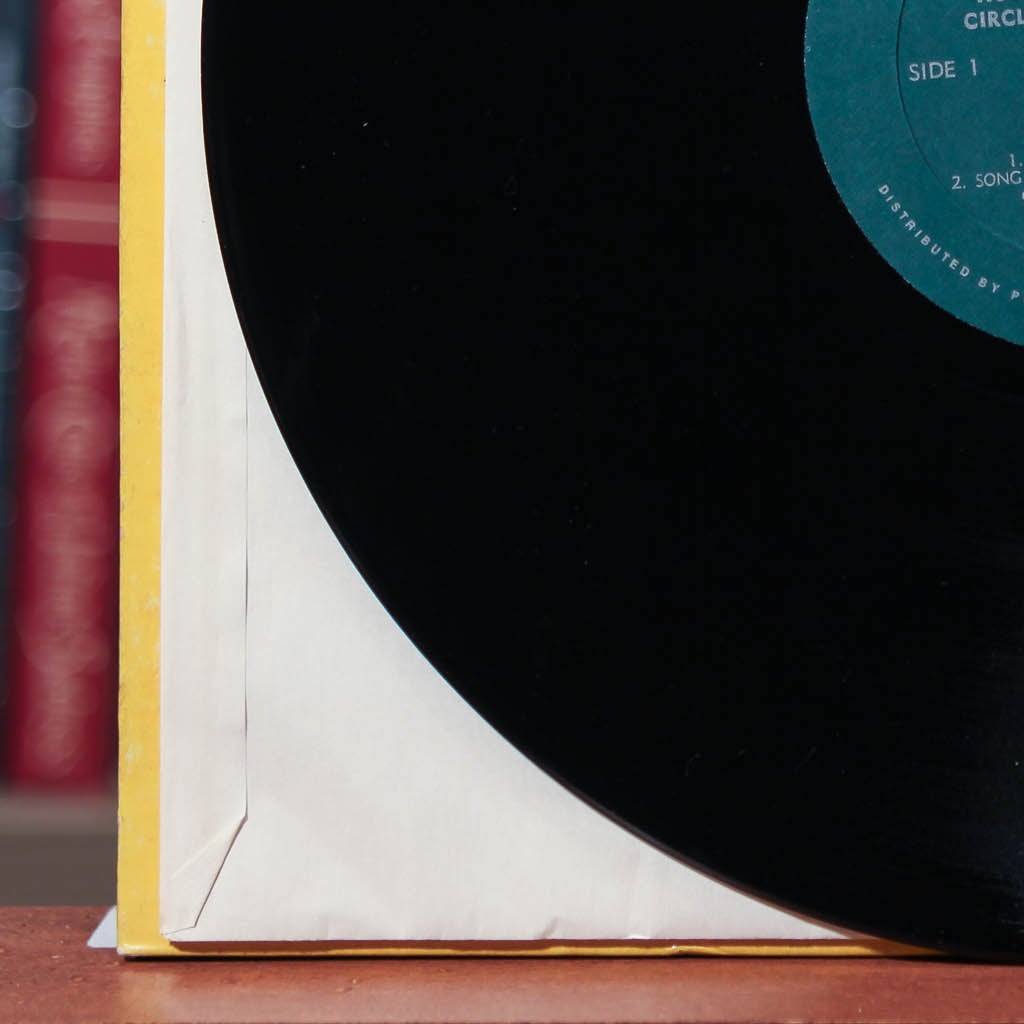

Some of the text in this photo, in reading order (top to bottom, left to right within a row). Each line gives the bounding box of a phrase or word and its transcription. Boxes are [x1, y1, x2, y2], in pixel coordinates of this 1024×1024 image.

[909, 58, 977, 82] SIDE 1
[1009, 153, 1023, 168] 1.
[951, 175, 966, 190] 2.
[975, 170, 1022, 188] SONG
[878, 184, 970, 277] DISTRIBUTED
[978, 277, 1001, 294] BY
